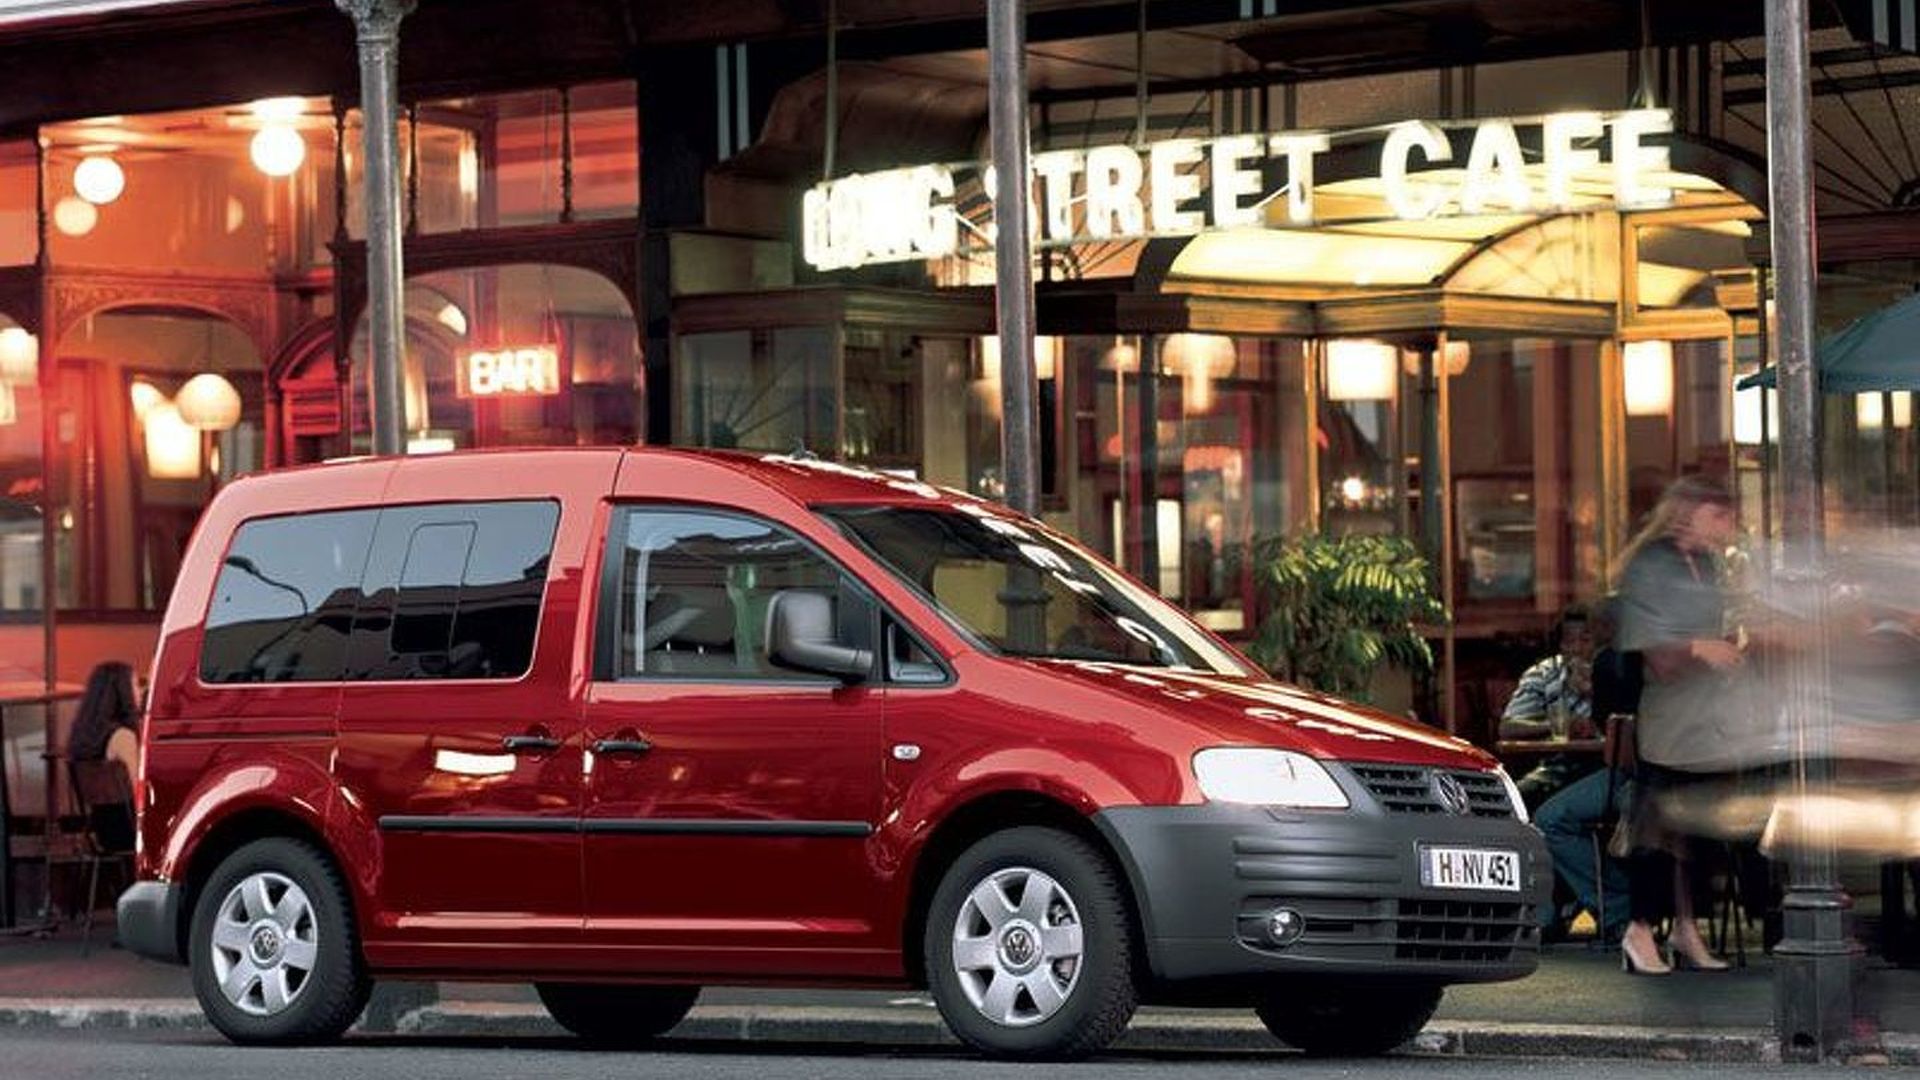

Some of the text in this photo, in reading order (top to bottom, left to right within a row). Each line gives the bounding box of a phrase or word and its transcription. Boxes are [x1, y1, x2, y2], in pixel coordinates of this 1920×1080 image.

[1381, 107, 1673, 220] CAFE
[469, 347, 551, 395] BAR
[1439, 851, 1514, 886] H NV 451
